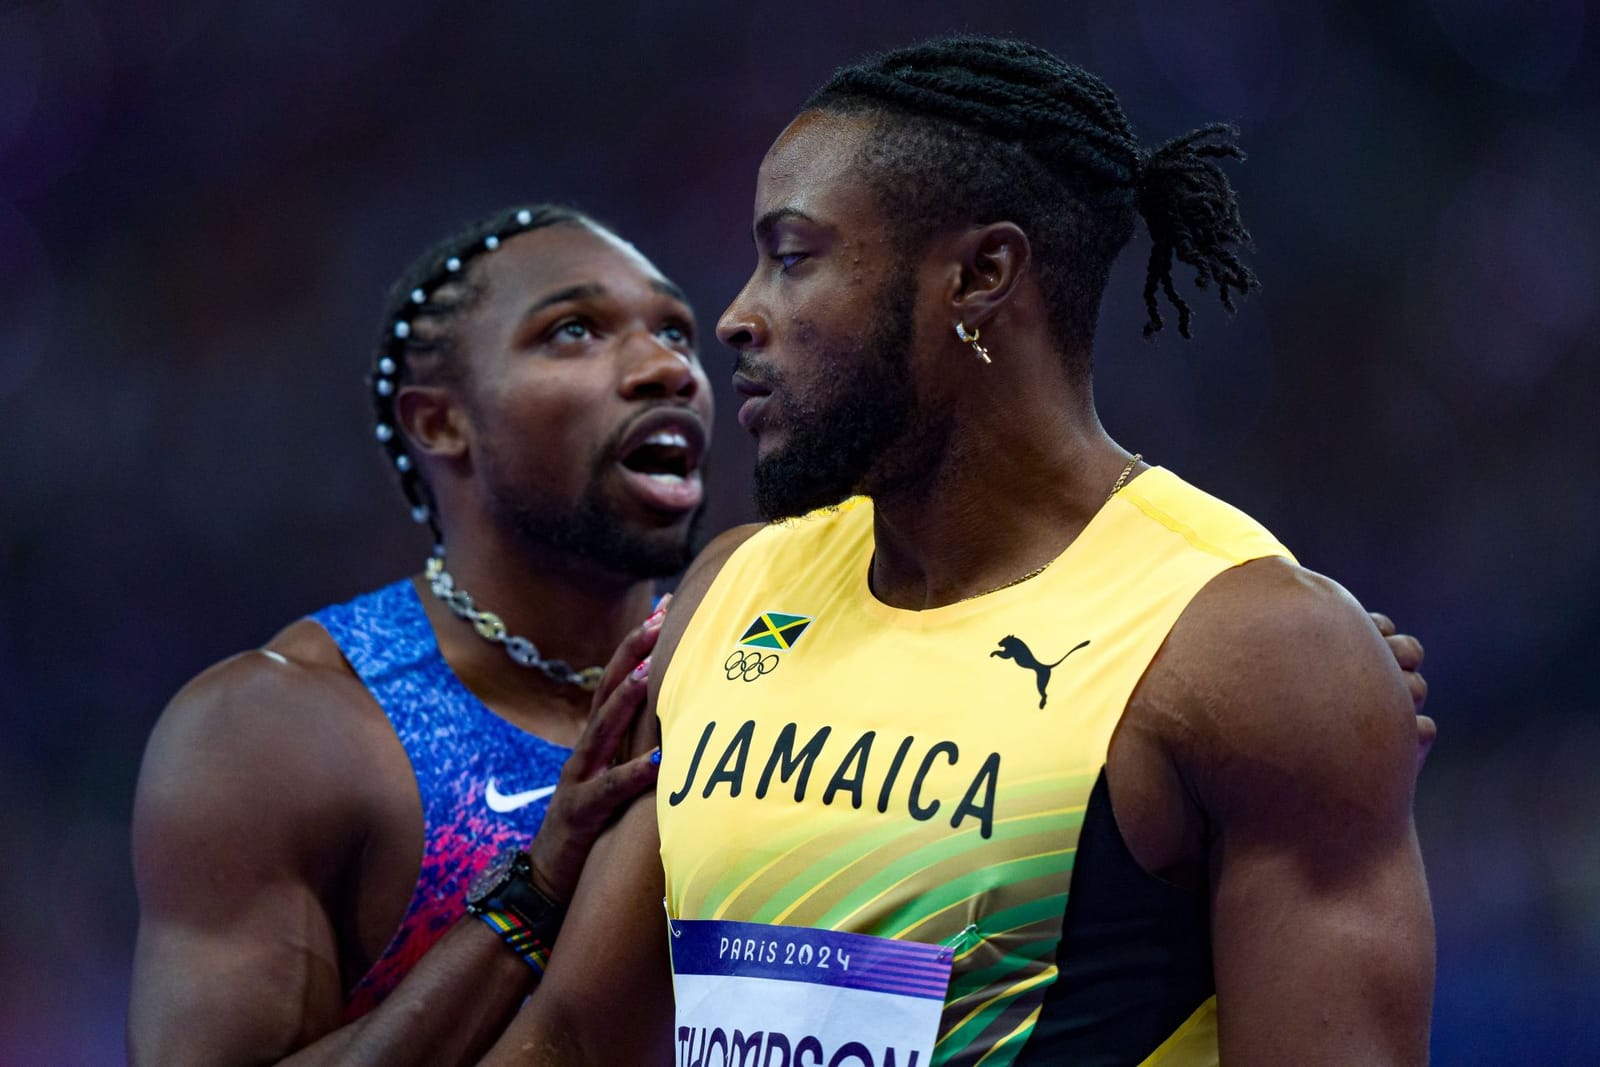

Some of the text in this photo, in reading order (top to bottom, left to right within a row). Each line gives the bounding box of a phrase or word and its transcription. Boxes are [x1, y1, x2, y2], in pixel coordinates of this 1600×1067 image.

[669, 719, 1001, 840] JAMAICA
[783, 942, 850, 972] 2024
[678, 1025, 921, 1067] THOMP
